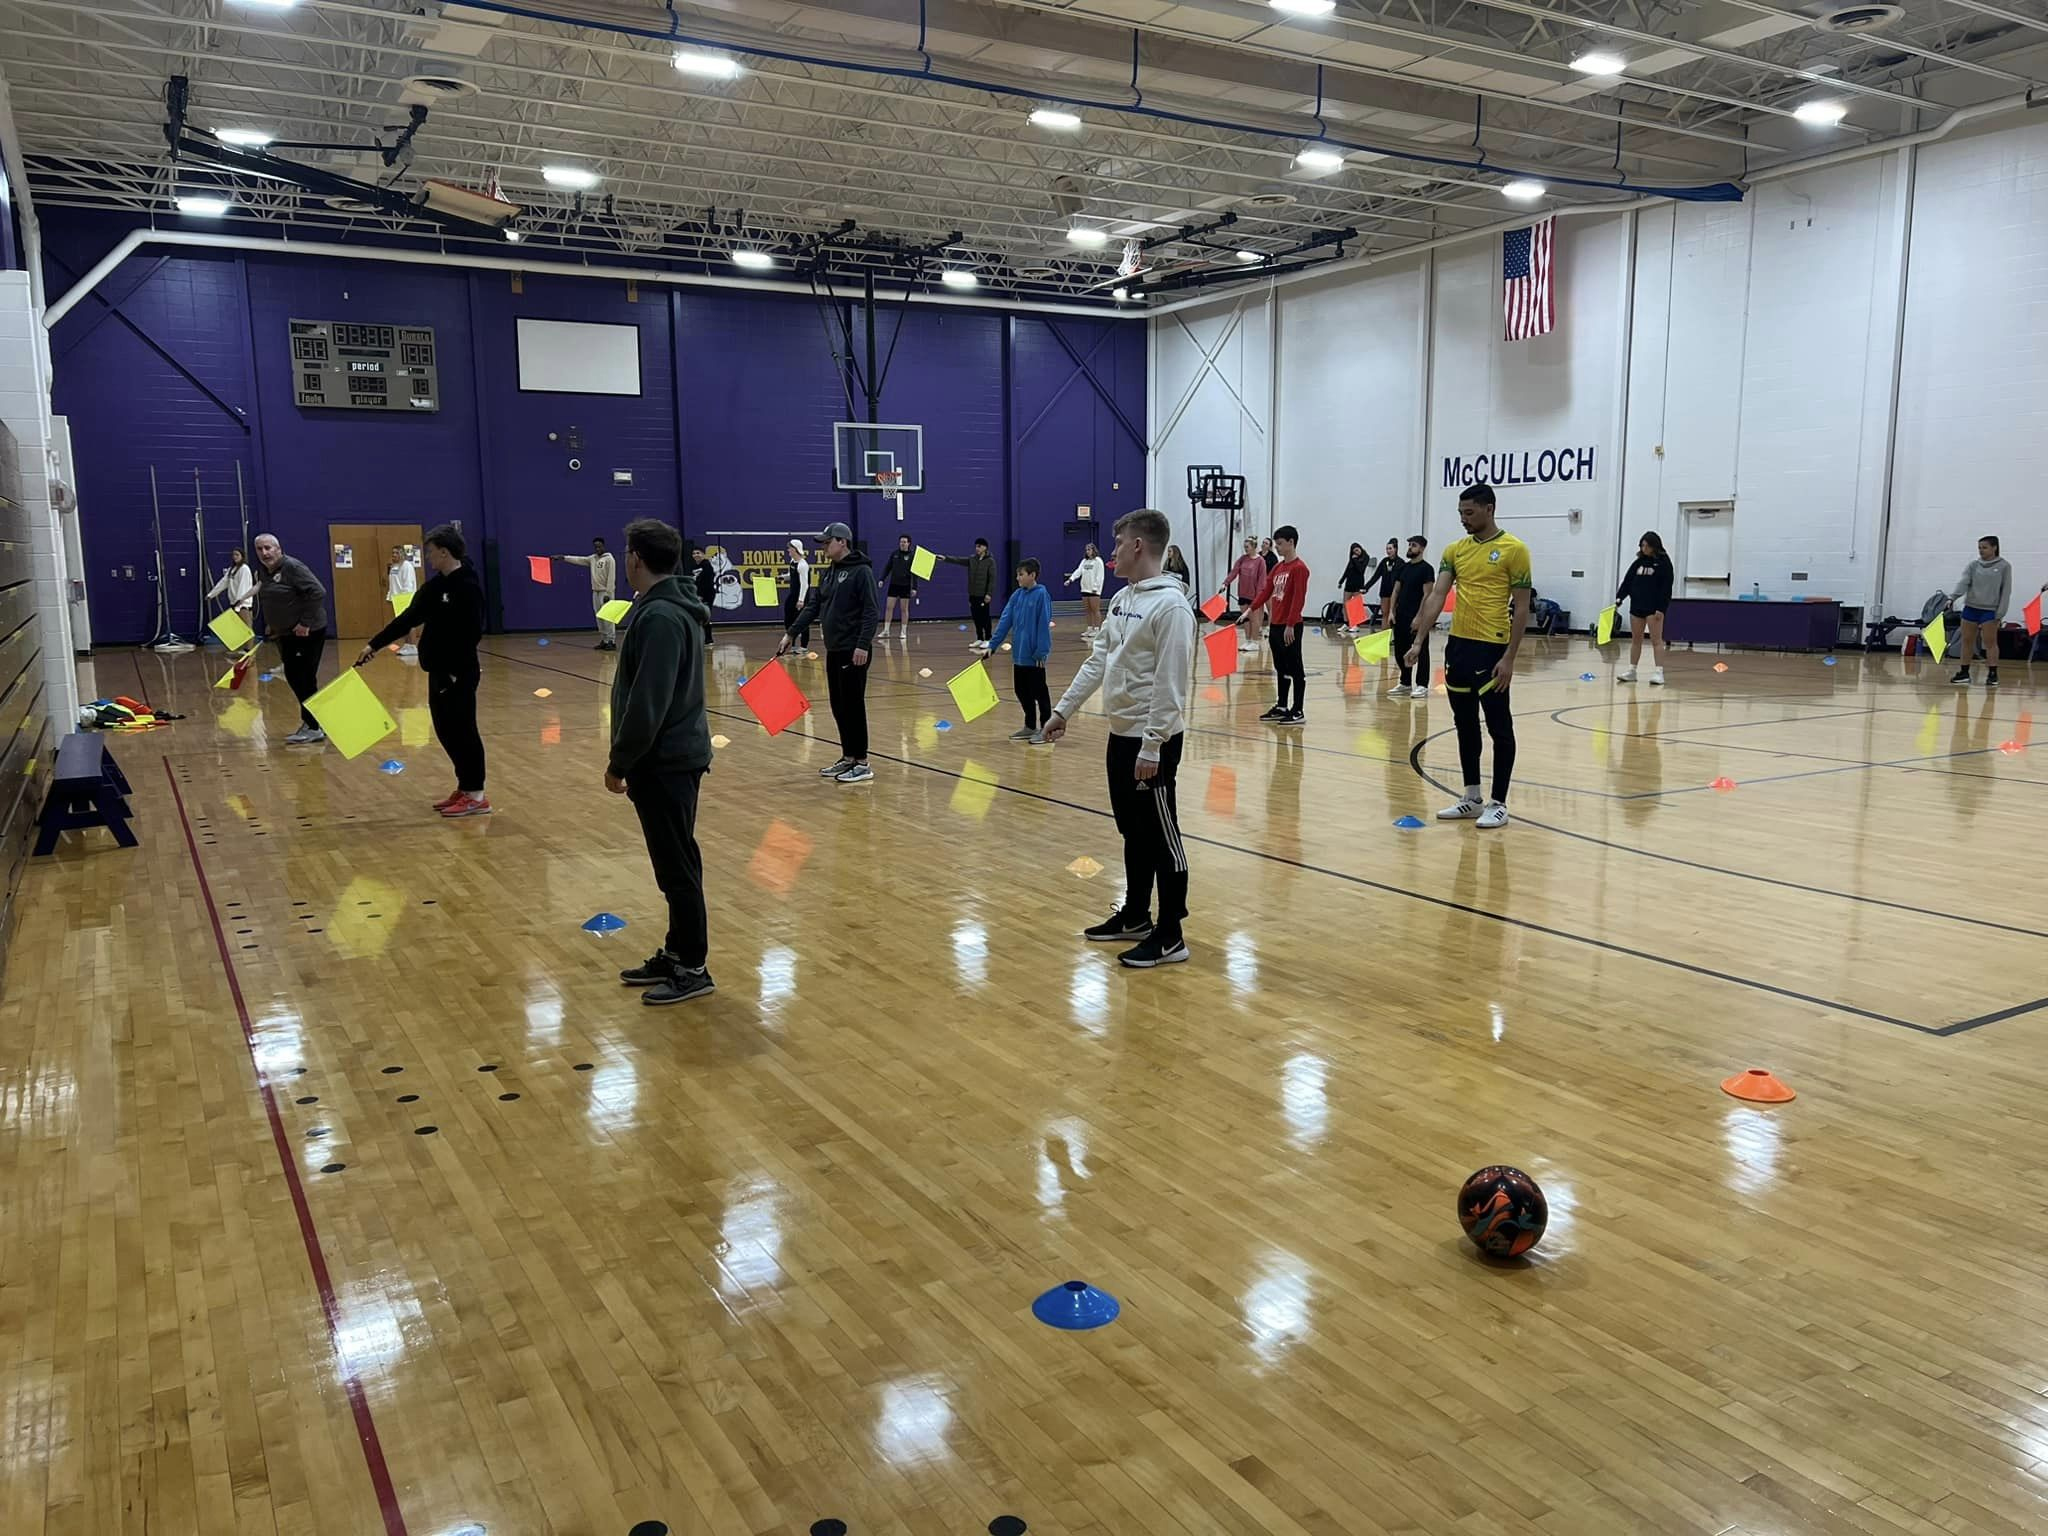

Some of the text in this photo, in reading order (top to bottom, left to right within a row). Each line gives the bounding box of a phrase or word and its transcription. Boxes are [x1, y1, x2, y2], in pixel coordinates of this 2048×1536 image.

[351, 361, 380, 372] period
[1443, 446, 1594, 487] McCULLOCH
[743, 550, 785, 565] HOME
